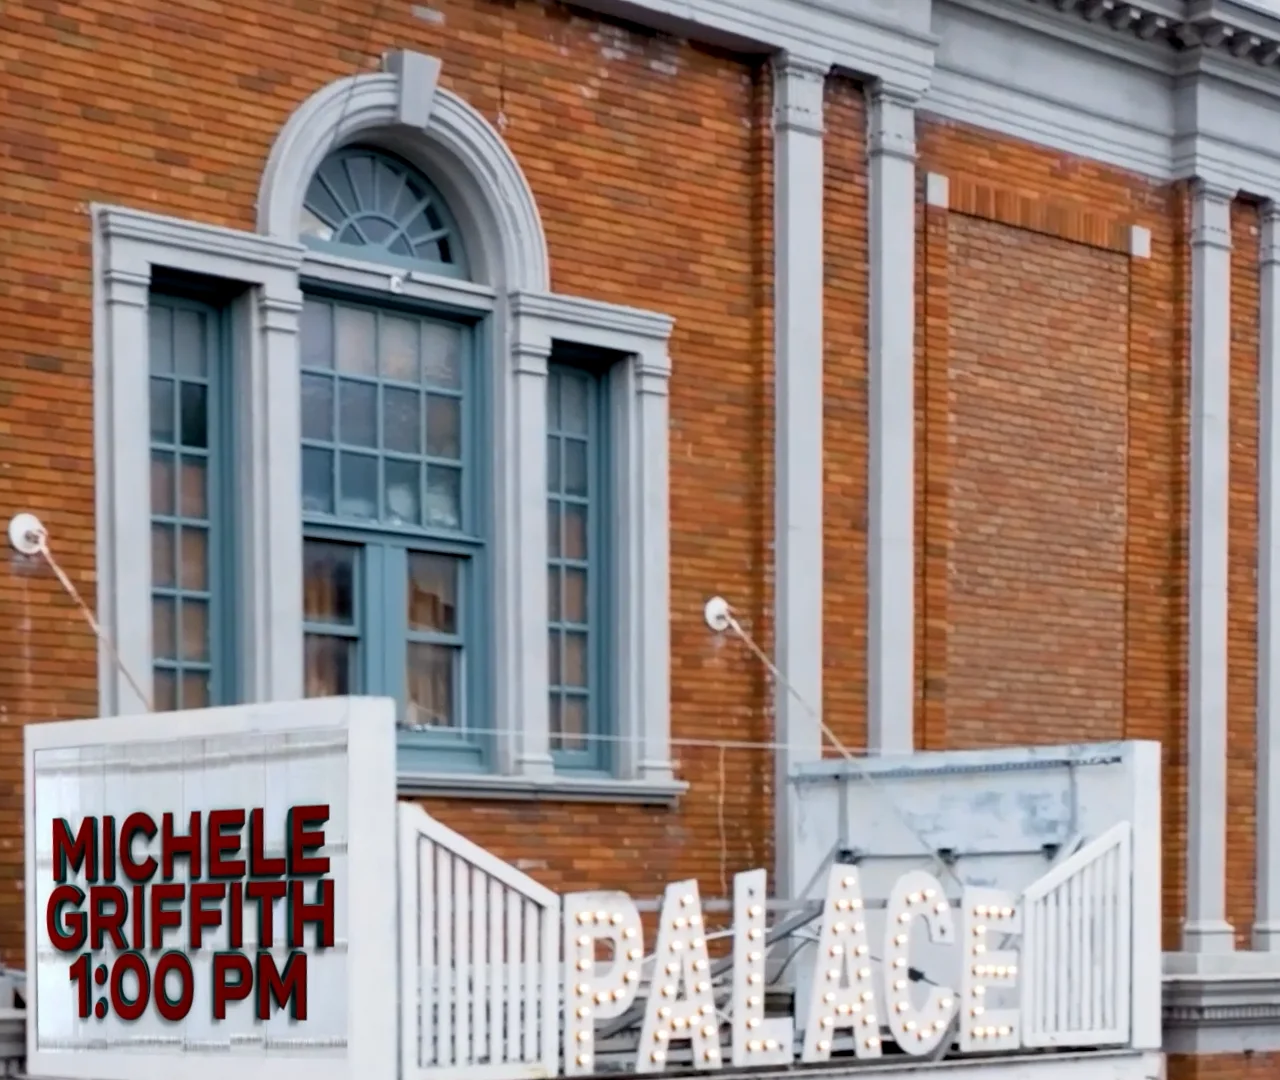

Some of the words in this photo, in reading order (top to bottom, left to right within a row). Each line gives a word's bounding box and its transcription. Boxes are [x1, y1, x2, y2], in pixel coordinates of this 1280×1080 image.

[52, 804, 332, 883] MICHELE
[46, 878, 336, 952] GRIFFITH
[68, 950, 195, 1022] 1:00
[213, 951, 308, 1022] PM
[564, 864, 1022, 1076] PALACE
